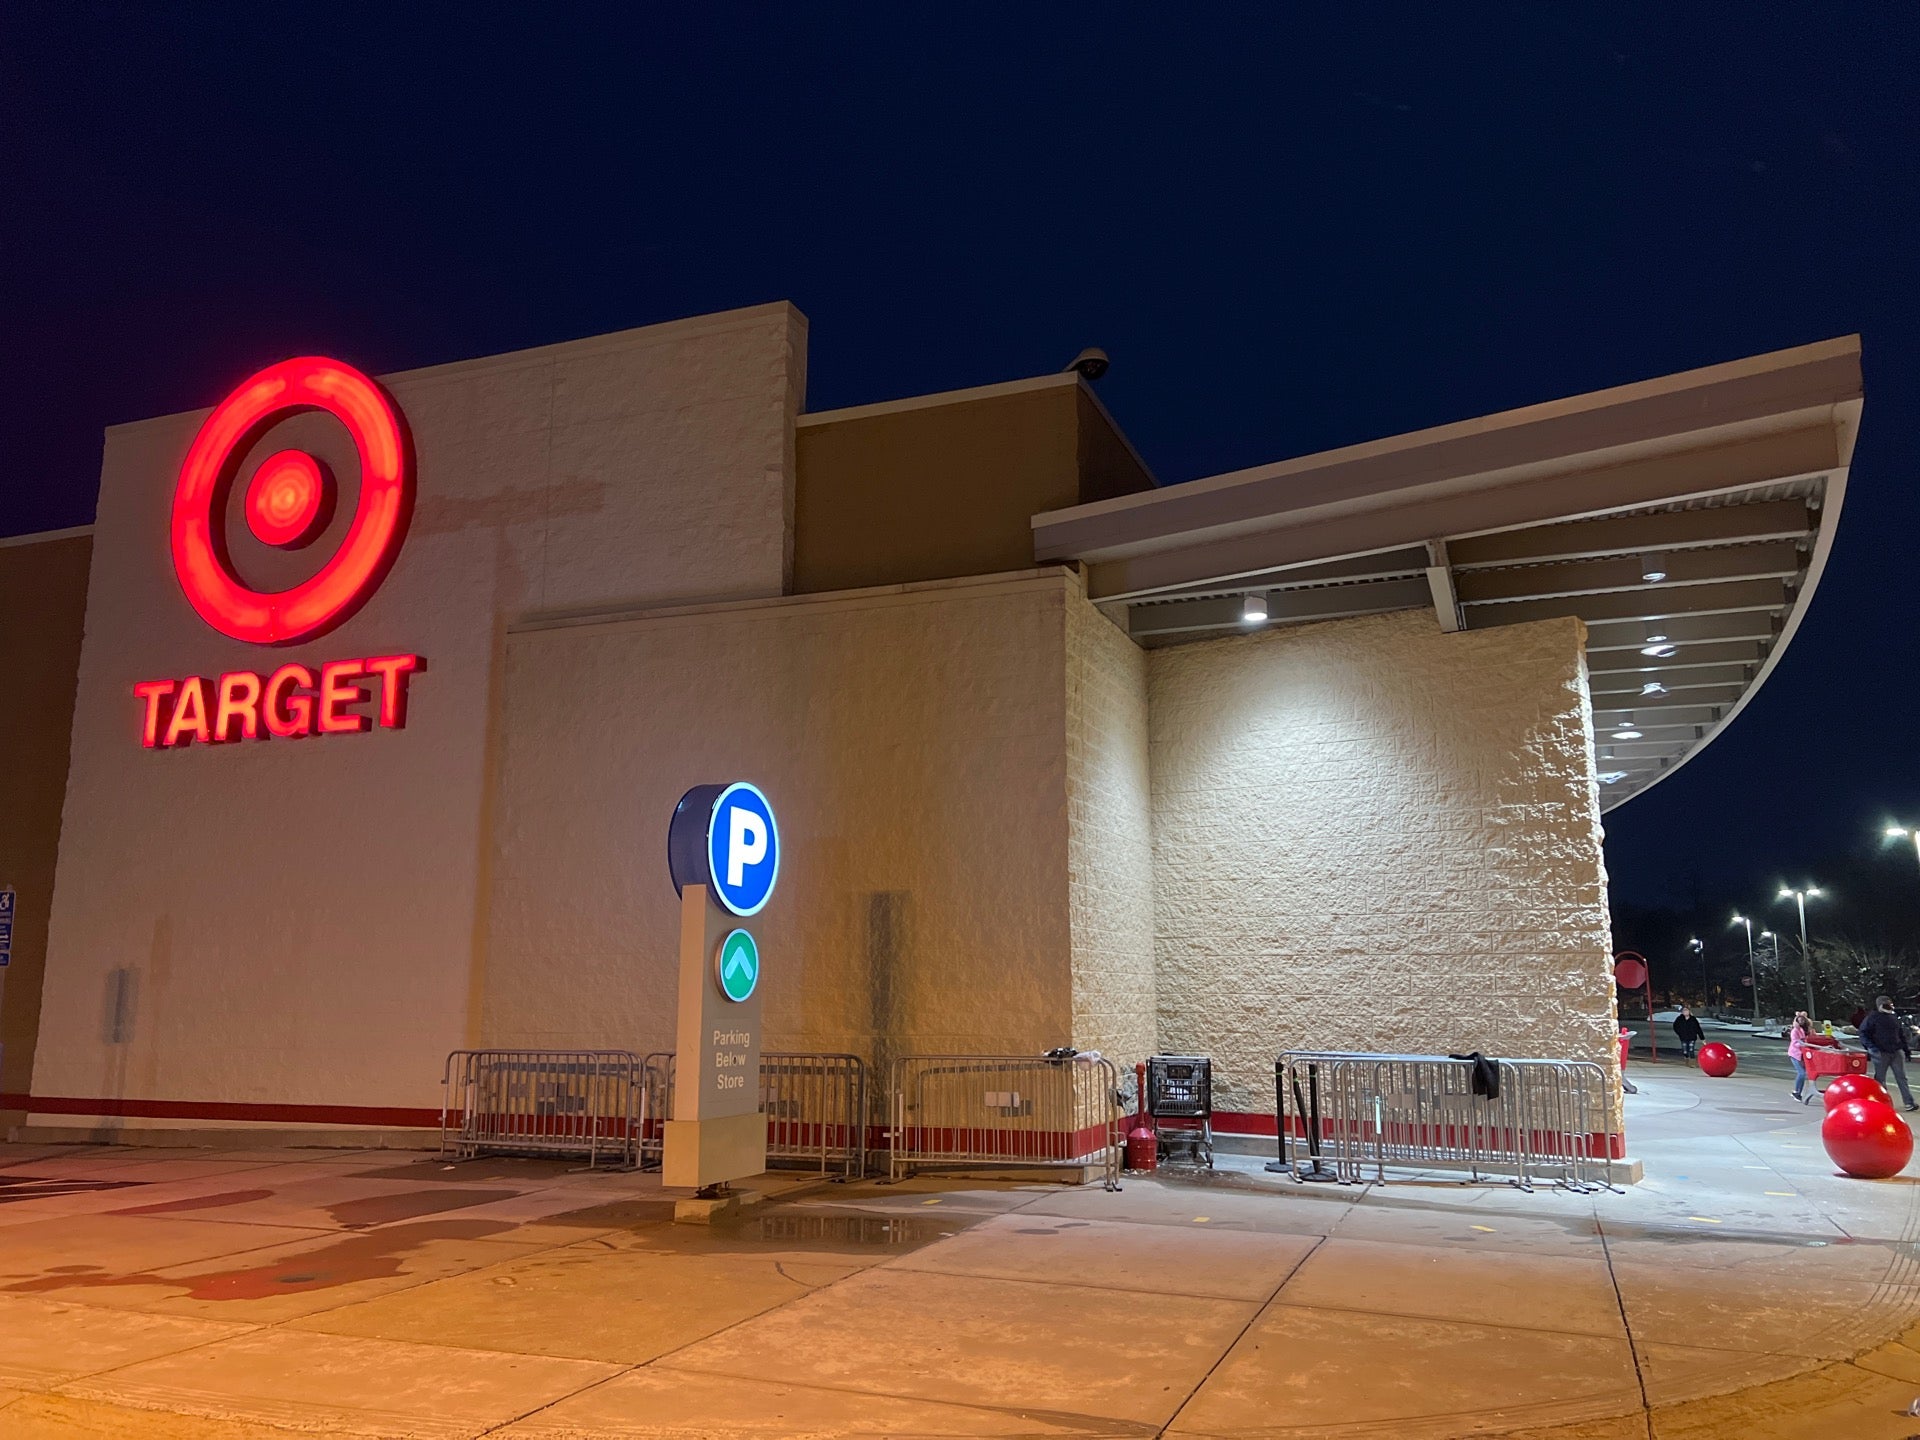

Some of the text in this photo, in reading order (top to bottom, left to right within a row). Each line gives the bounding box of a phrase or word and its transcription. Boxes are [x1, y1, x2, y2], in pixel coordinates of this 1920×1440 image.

[134, 653, 421, 749] TARGET
[727, 806, 768, 888] P
[713, 1030, 750, 1048] Parking
[715, 1051, 746, 1067] Below
[717, 1073, 745, 1090] Store
